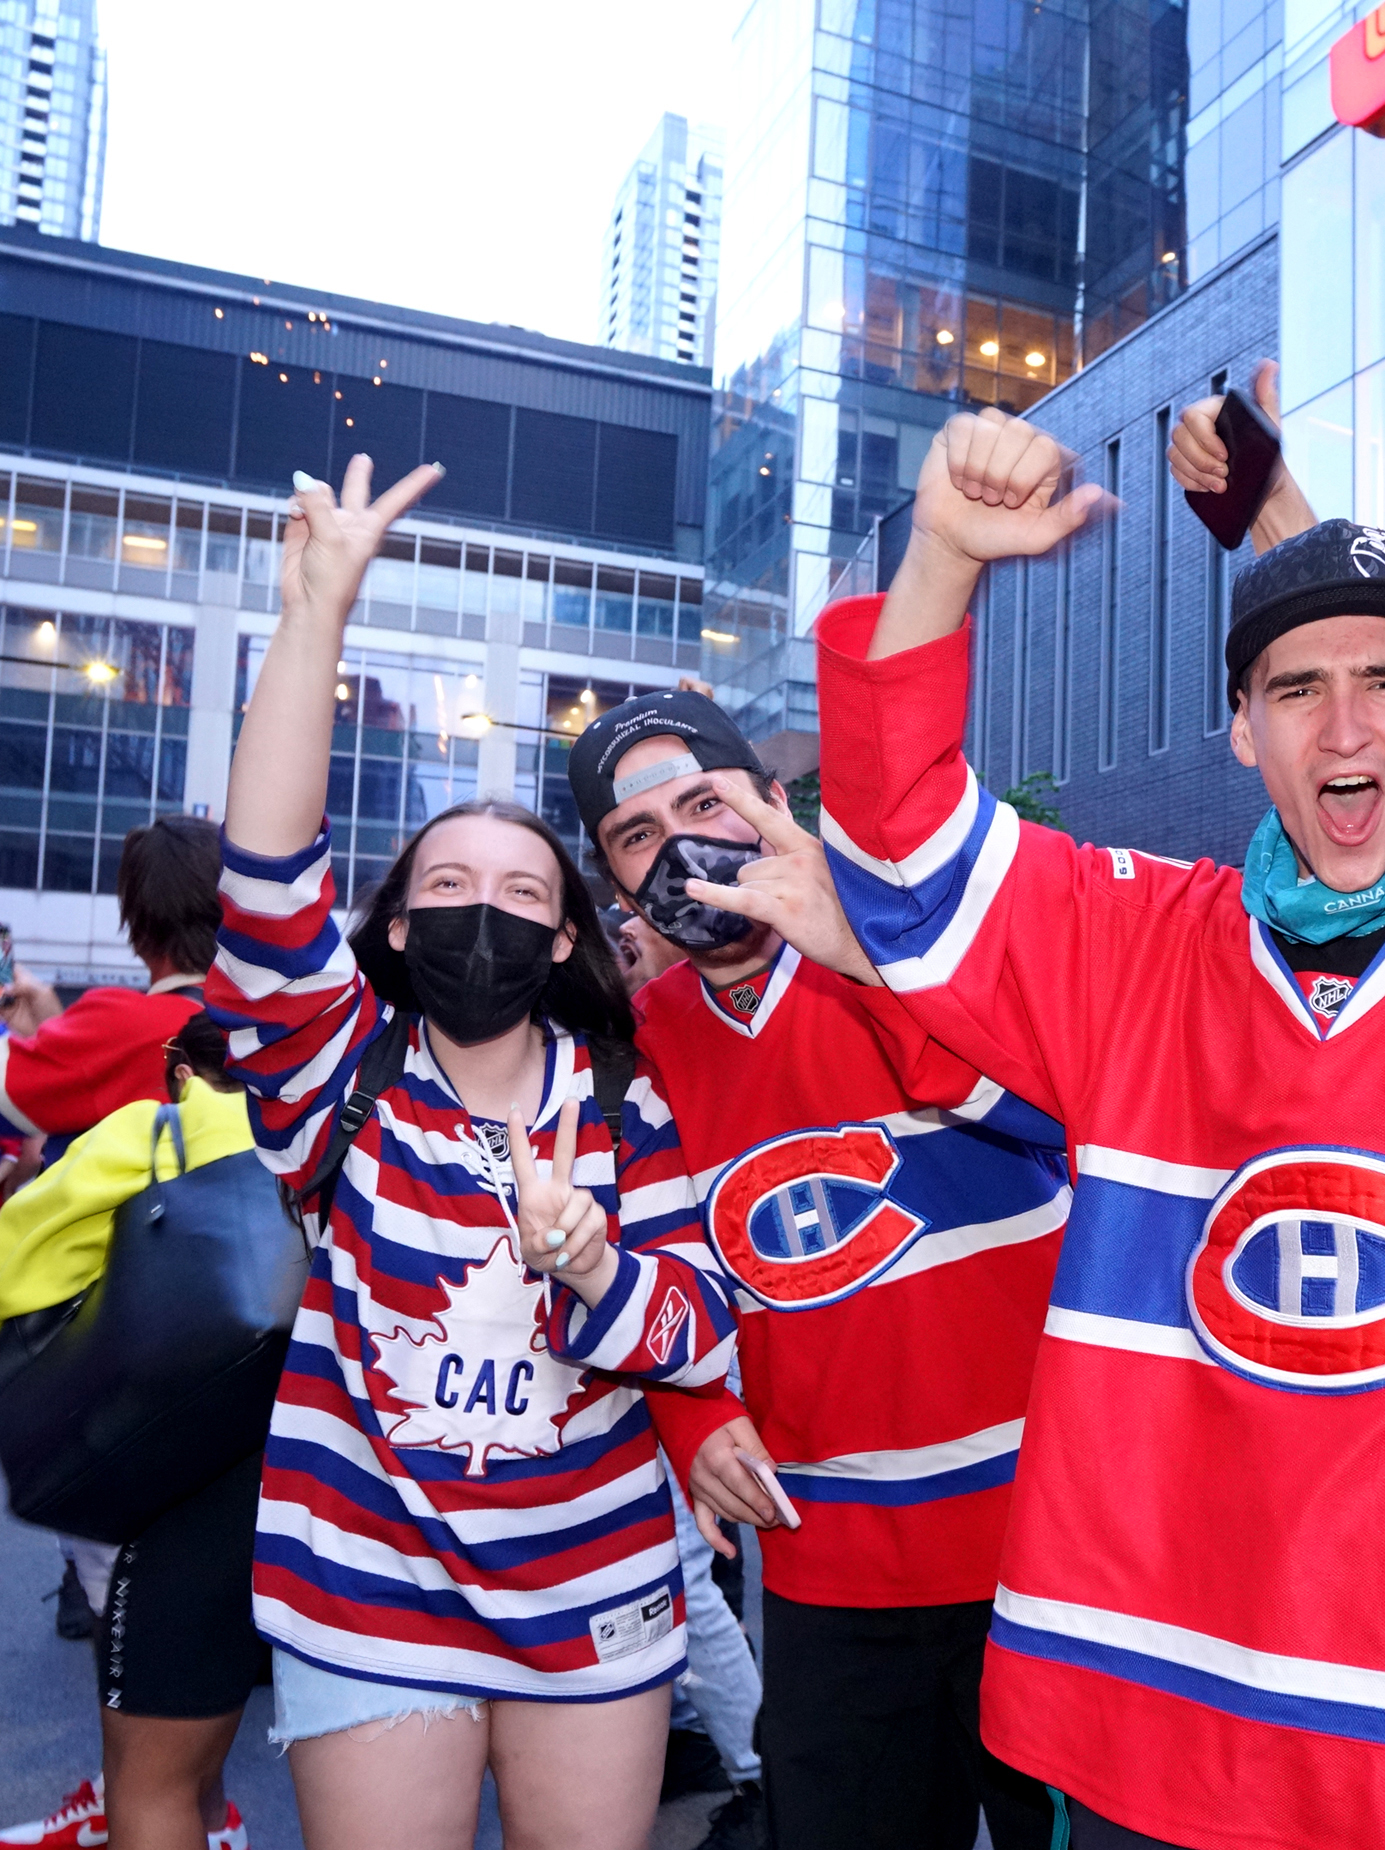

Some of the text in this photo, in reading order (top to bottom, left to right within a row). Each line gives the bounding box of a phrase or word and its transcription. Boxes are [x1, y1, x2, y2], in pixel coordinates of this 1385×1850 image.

[614, 709, 658, 732] Premium
[1323, 886, 1385, 913] CANNA
[434, 1353, 535, 1416] CAC
